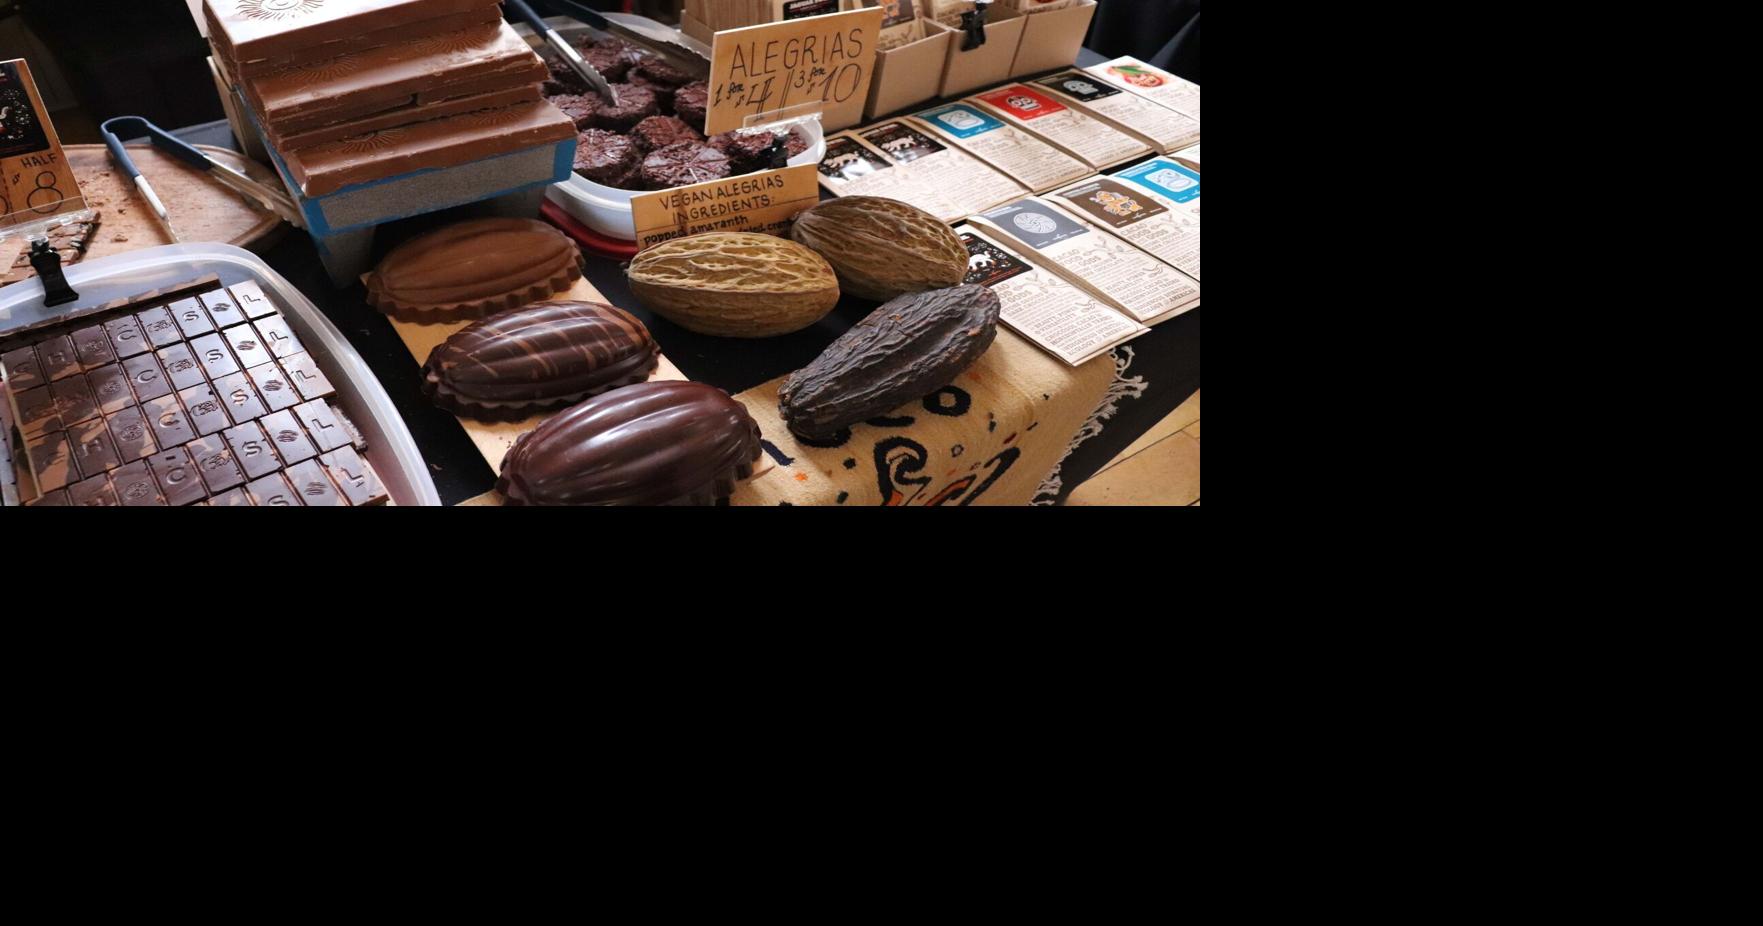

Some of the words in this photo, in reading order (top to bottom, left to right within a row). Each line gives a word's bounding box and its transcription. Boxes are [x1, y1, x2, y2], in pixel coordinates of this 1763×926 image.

[729, 28, 863, 80] ALEGRIAS
[794, 71, 805, 88] 3
[20, 152, 57, 169] HALF
[659, 188, 713, 211] VEGAN
[716, 174, 784, 198] ALEGRIAS
[690, 214, 749, 234] amaranth
